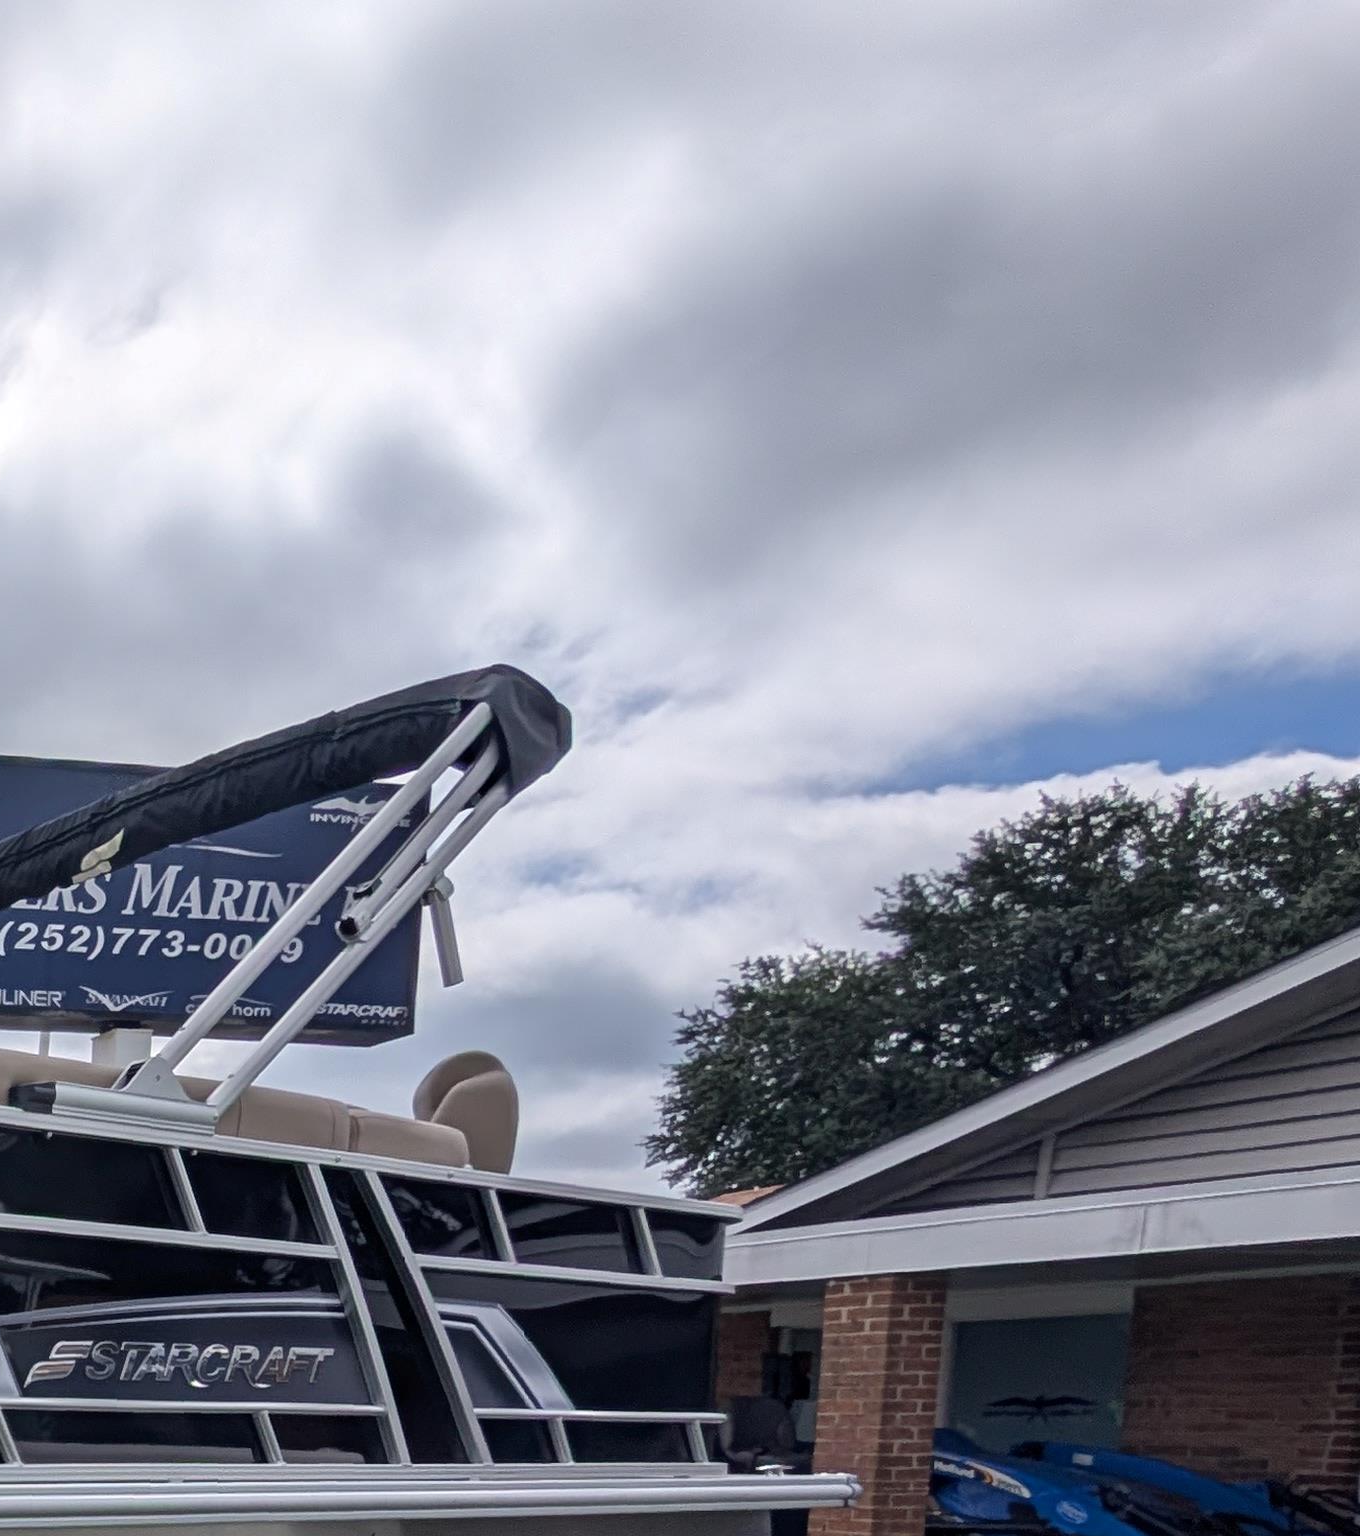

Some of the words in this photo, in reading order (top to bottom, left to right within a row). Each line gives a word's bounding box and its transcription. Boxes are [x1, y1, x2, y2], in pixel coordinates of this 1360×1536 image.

[121, 863, 322, 926] MARIN
[232, 1003, 272, 1018] horn
[85, 1340, 335, 1388] STARCRAFT
